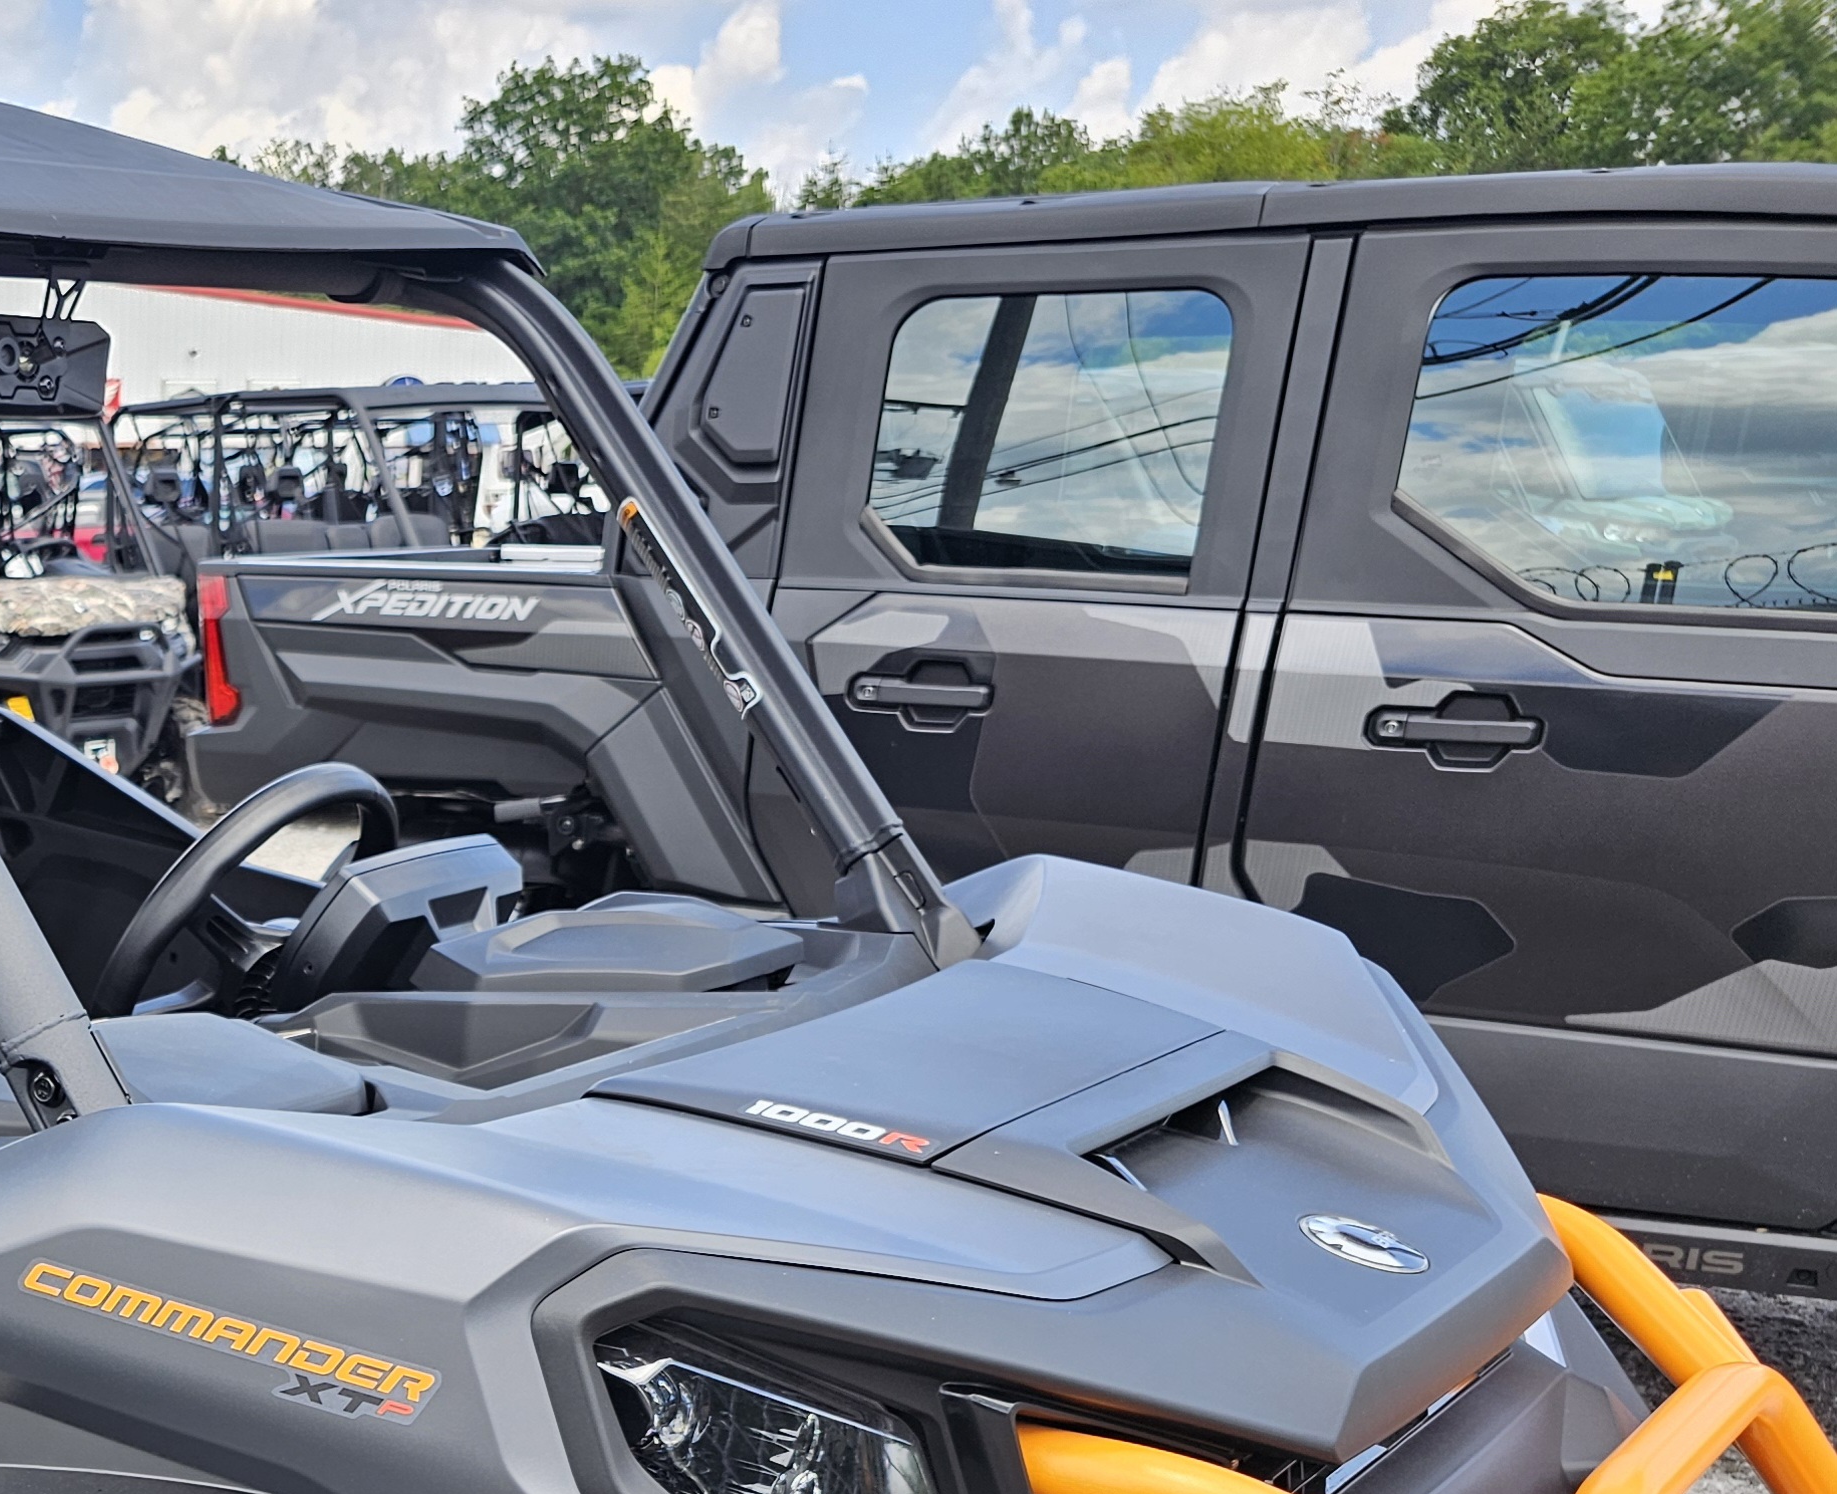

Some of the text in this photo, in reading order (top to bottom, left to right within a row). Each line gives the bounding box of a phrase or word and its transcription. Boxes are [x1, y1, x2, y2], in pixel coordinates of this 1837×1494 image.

[311, 579, 541, 621] XPEDITION
[745, 1100, 930, 1153] 1000R
[23, 1262, 436, 1403] COMMANDER
[279, 1374, 415, 1417] XTP
